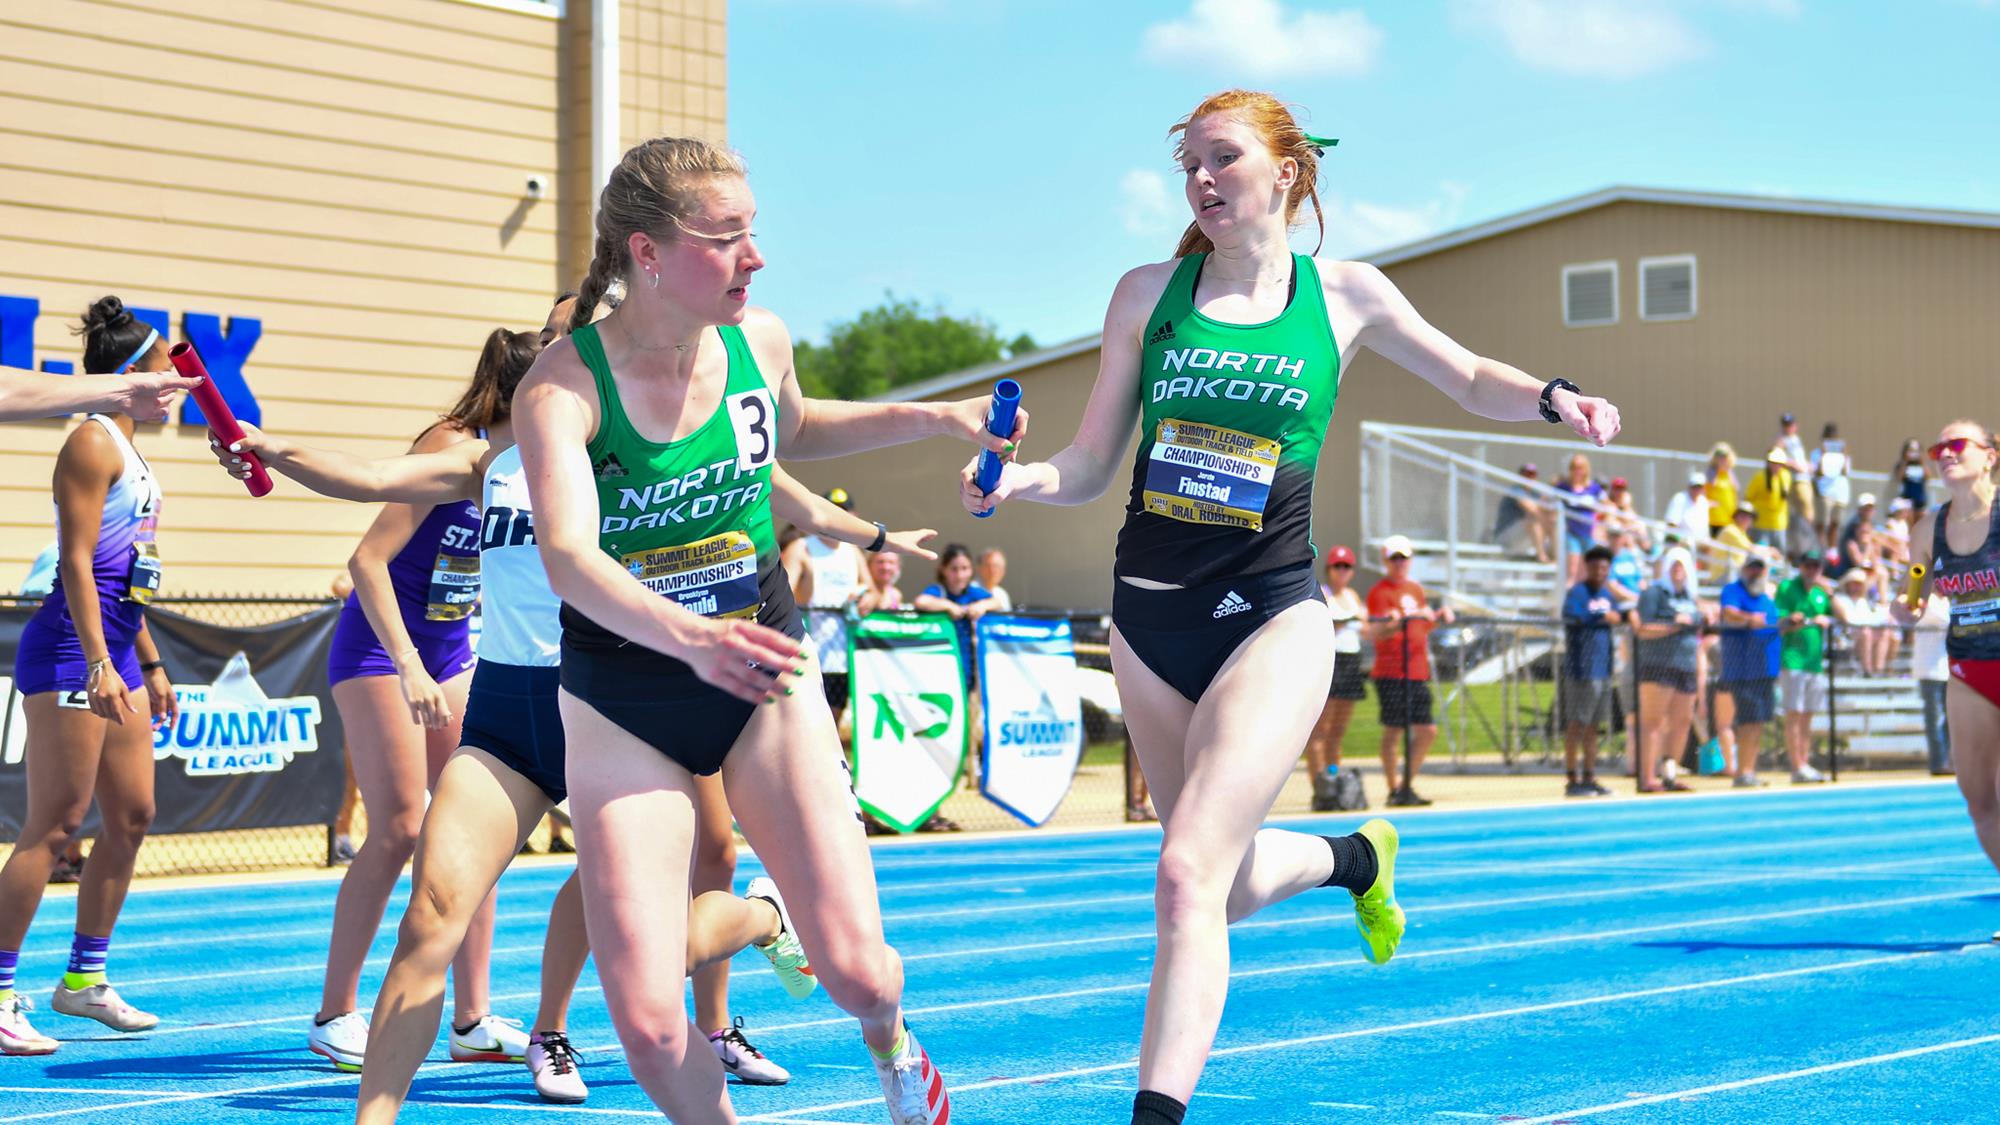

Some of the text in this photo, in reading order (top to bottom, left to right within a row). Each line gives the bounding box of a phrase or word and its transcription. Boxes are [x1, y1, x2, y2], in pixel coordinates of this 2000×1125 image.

[1161, 348, 1306, 380] NORTH
[1152, 376, 1310, 412] DAKOTA
[740, 394, 769, 464] 3
[1178, 424, 1256, 449] SUMMIT LEAGUE
[1176, 435, 1254, 458] OUTDOOR TRACK & FIELD
[1163, 446, 1261, 479] CHAMPIONSHIPS
[1178, 476, 1231, 503] Finstad
[601, 481, 763, 534] DAKOTA
[1171, 504, 1196, 521] ORAL
[1193, 501, 1217, 512] HOSTED
[645, 548, 690, 566] SUMMIT
[693, 538, 729, 555] LEAGUE
[646, 563, 679, 576] OUTDOOR
[682, 558, 705, 569] TRACK
[714, 550, 731, 561] FIELD
[1213, 602, 1252, 619] adidas
[176, 692, 207, 703] THE
[191, 752, 275, 770] LEAGUE
